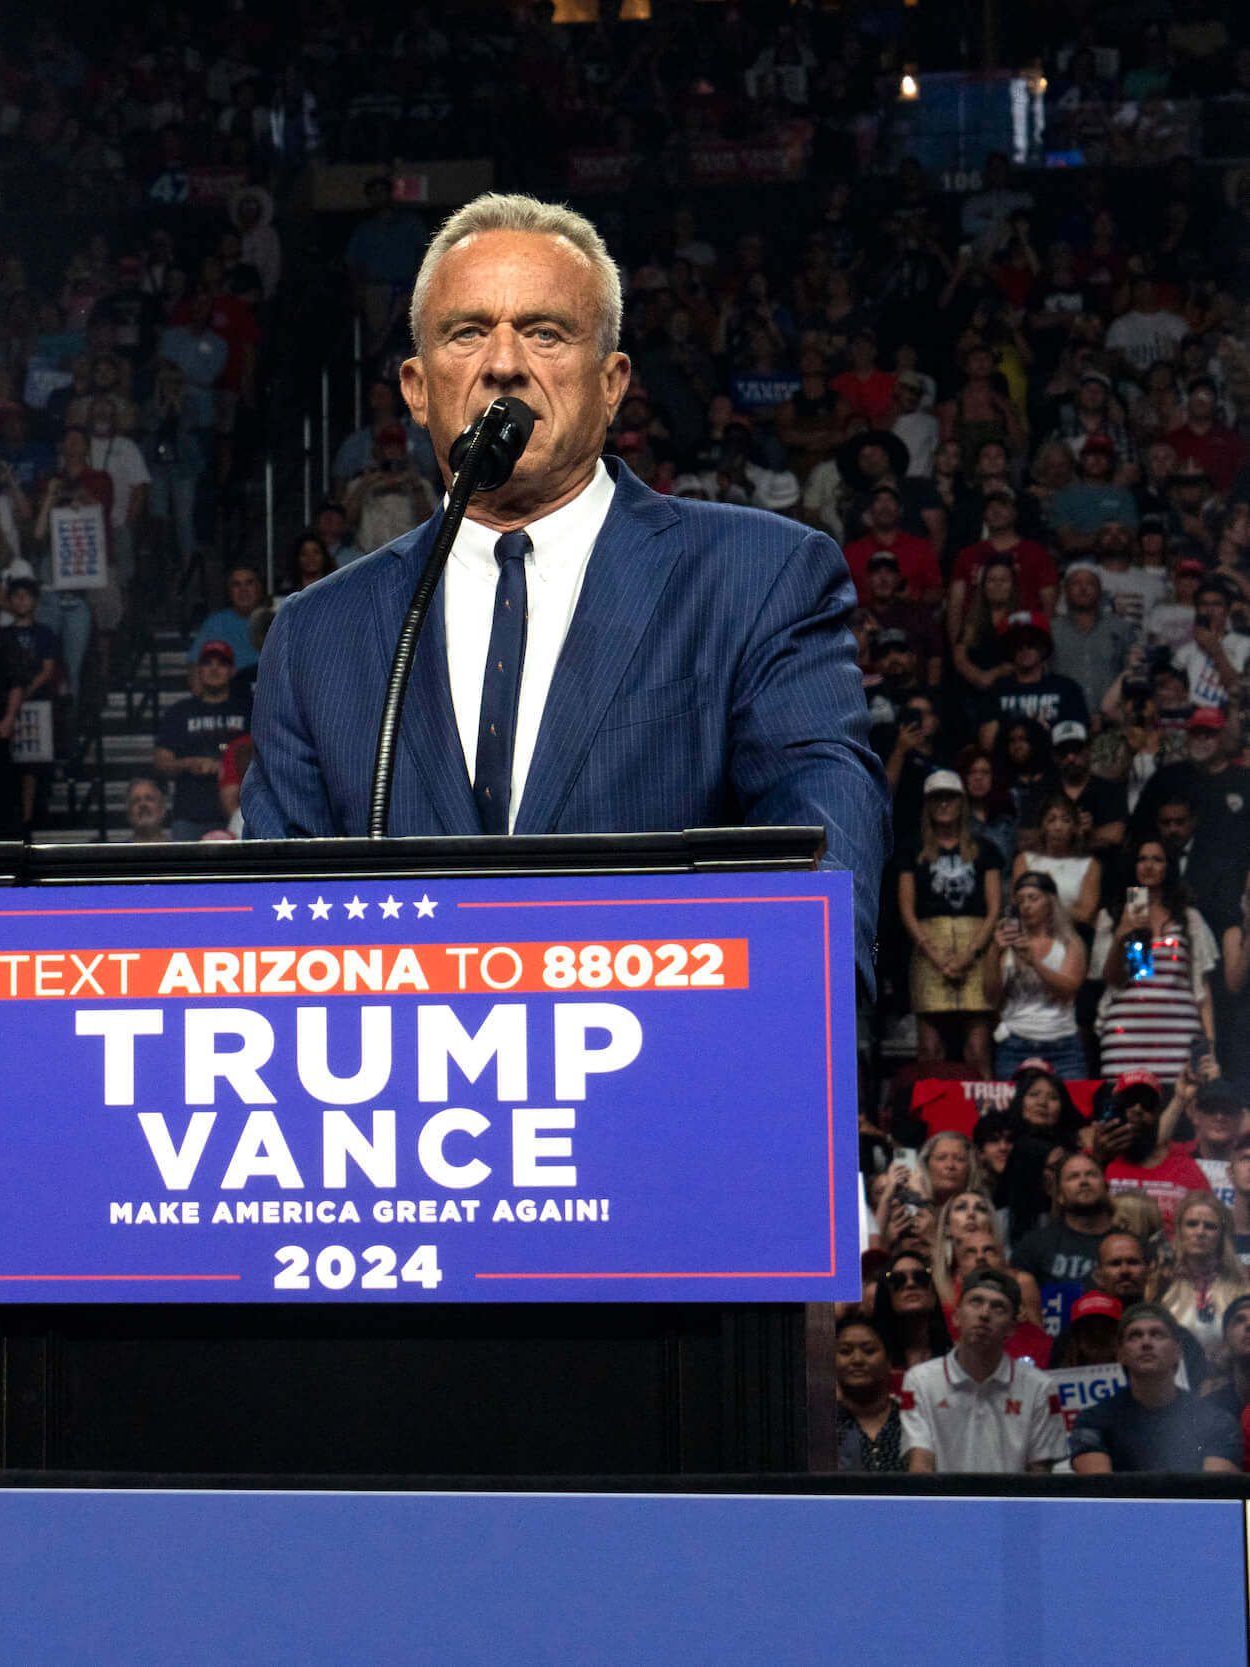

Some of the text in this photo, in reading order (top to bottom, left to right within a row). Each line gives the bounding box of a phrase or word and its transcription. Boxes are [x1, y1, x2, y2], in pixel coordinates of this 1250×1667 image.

[158, 948, 430, 995] ARIZONA
[445, 946, 523, 990] TO
[542, 942, 725, 989] 88022
[75, 1002, 643, 1106] TRUMP
[137, 1107, 578, 1191] VANCE
[109, 1198, 610, 1225] MAKE AMERICA GREAT AGAIN!
[273, 1244, 443, 1290] 2024
